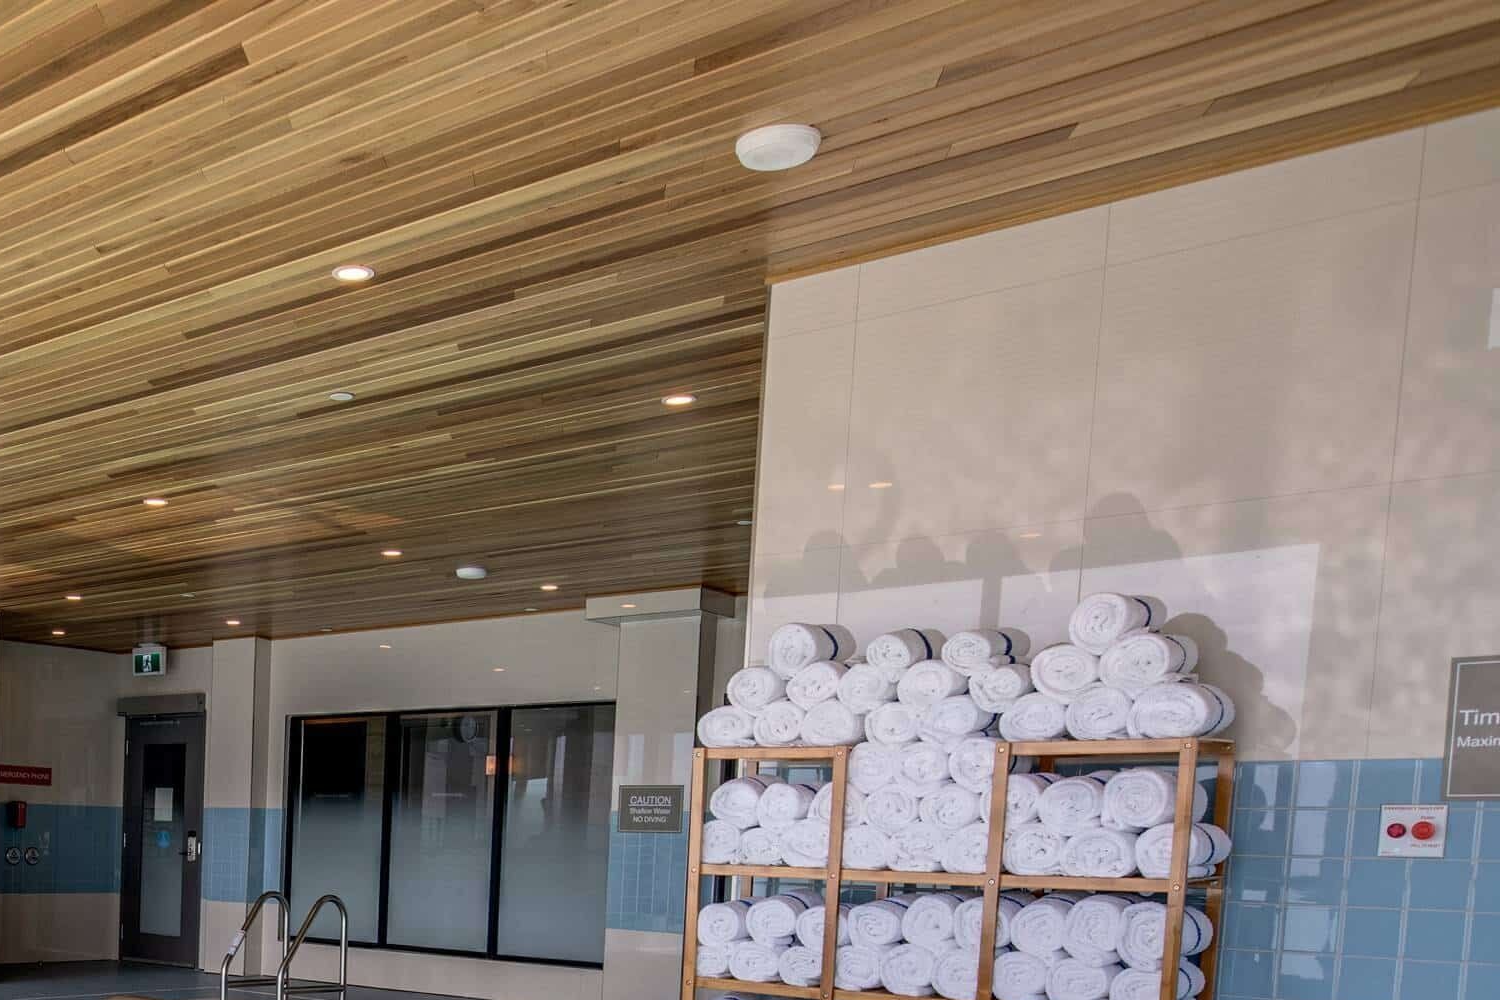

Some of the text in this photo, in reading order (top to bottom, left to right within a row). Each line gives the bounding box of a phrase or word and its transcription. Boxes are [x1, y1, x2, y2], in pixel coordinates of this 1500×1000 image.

[630, 795, 672, 805] CAUTION
[632, 815, 667, 823] NO DIVING
